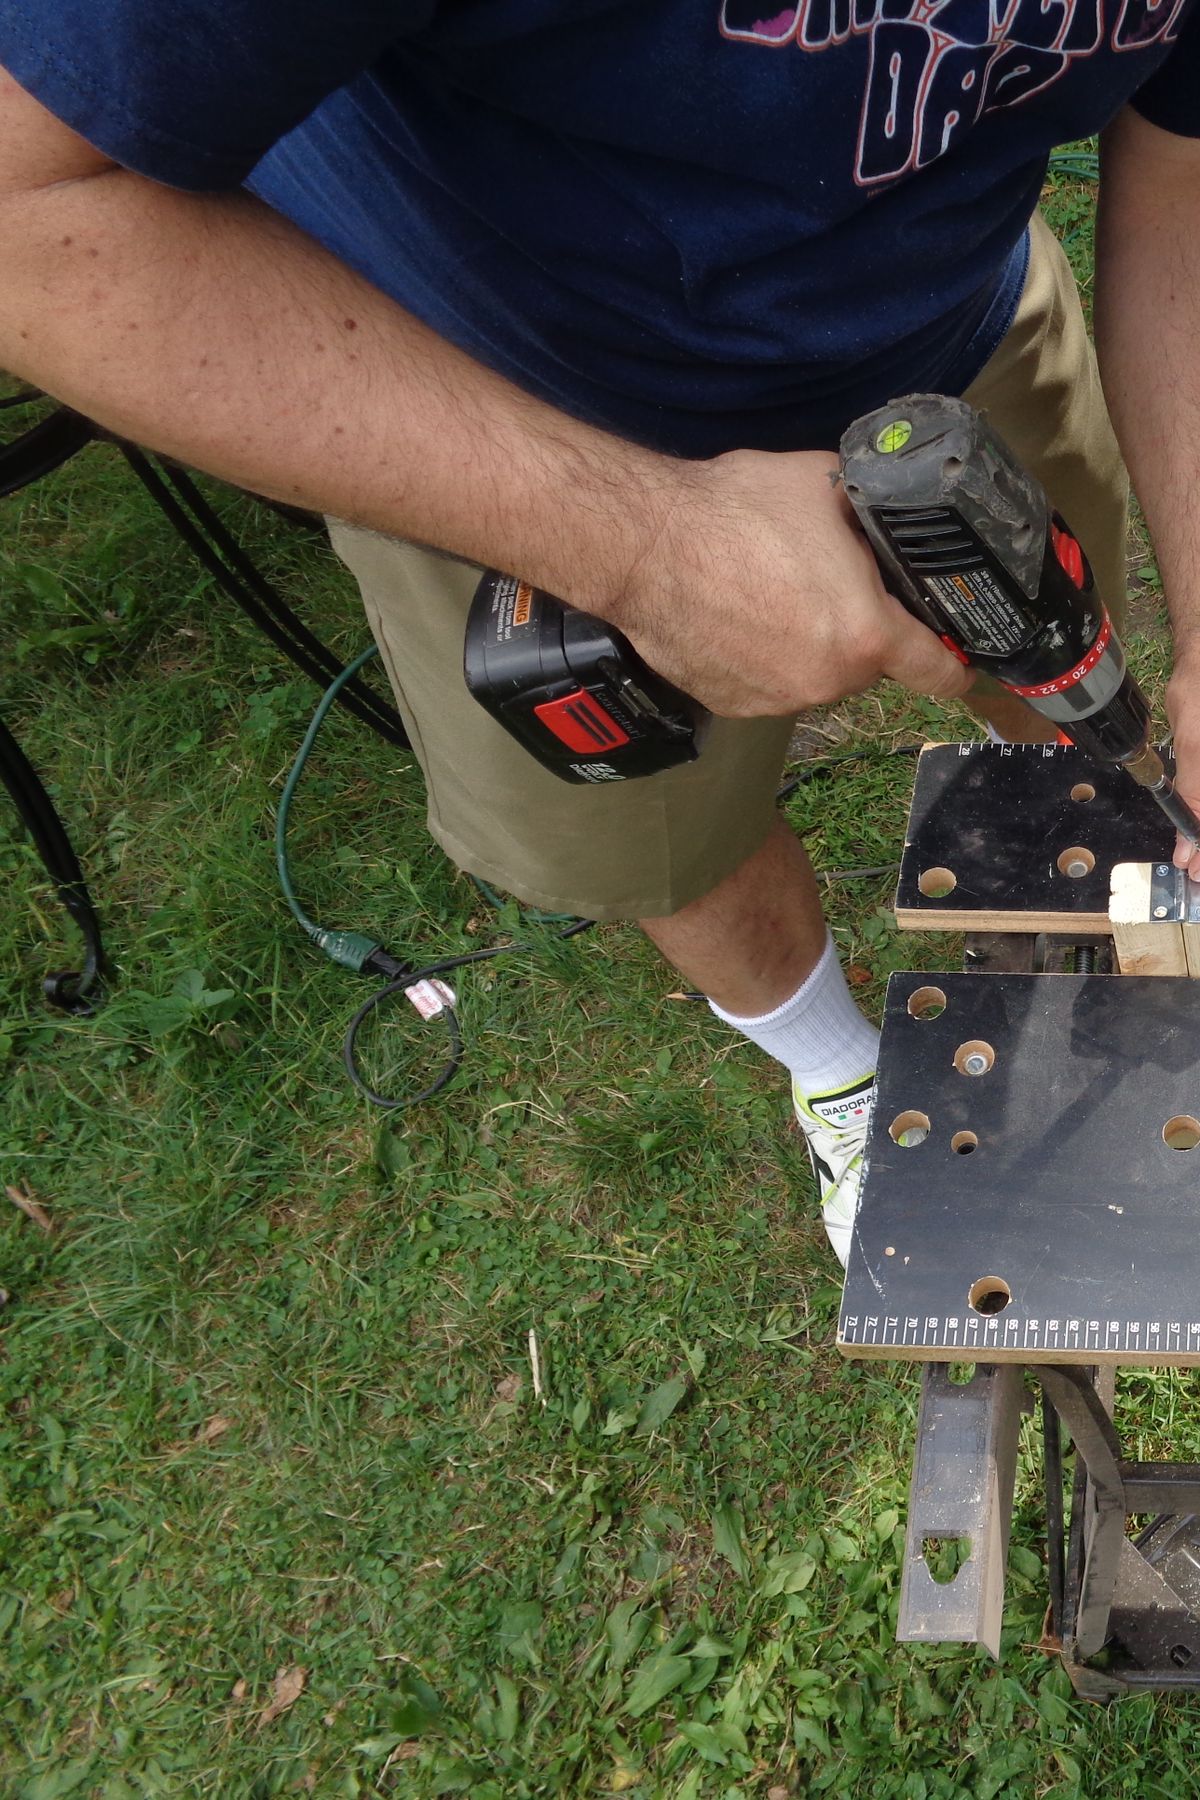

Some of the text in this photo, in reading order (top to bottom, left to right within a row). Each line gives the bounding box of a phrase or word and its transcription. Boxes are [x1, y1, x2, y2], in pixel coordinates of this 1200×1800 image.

[1072, 665, 1087, 679] 20
[1040, 685, 1058, 694] 22
[962, 747, 969, 756] 28
[1004, 748, 1011, 756] 27
[1045, 748, 1053, 756] 26
[821, 1095, 872, 1116] DIADORA
[848, 1316, 858, 1326] 73
[868, 1317, 878, 1327] 72
[888, 1317, 898, 1327] 71
[908, 1317, 918, 1328] 70
[928, 1318, 938, 1328] 69
[948, 1318, 958, 1328] 68
[969, 1319, 979, 1329] 67
[989, 1319, 999, 1329] 66
[1009, 1319, 1019, 1330] 65
[1029, 1320, 1039, 1330] 64
[1049, 1320, 1059, 1331] 63
[1069, 1321, 1079, 1331] 62
[1090, 1321, 1099, 1331] 61
[1110, 1321, 1120, 1332] 60
[1130, 1322, 1140, 1332] 59
[1150, 1322, 1160, 1333] 58
[1171, 1323, 1180, 1333] 57
[1191, 1323, 1200, 1334] 56
